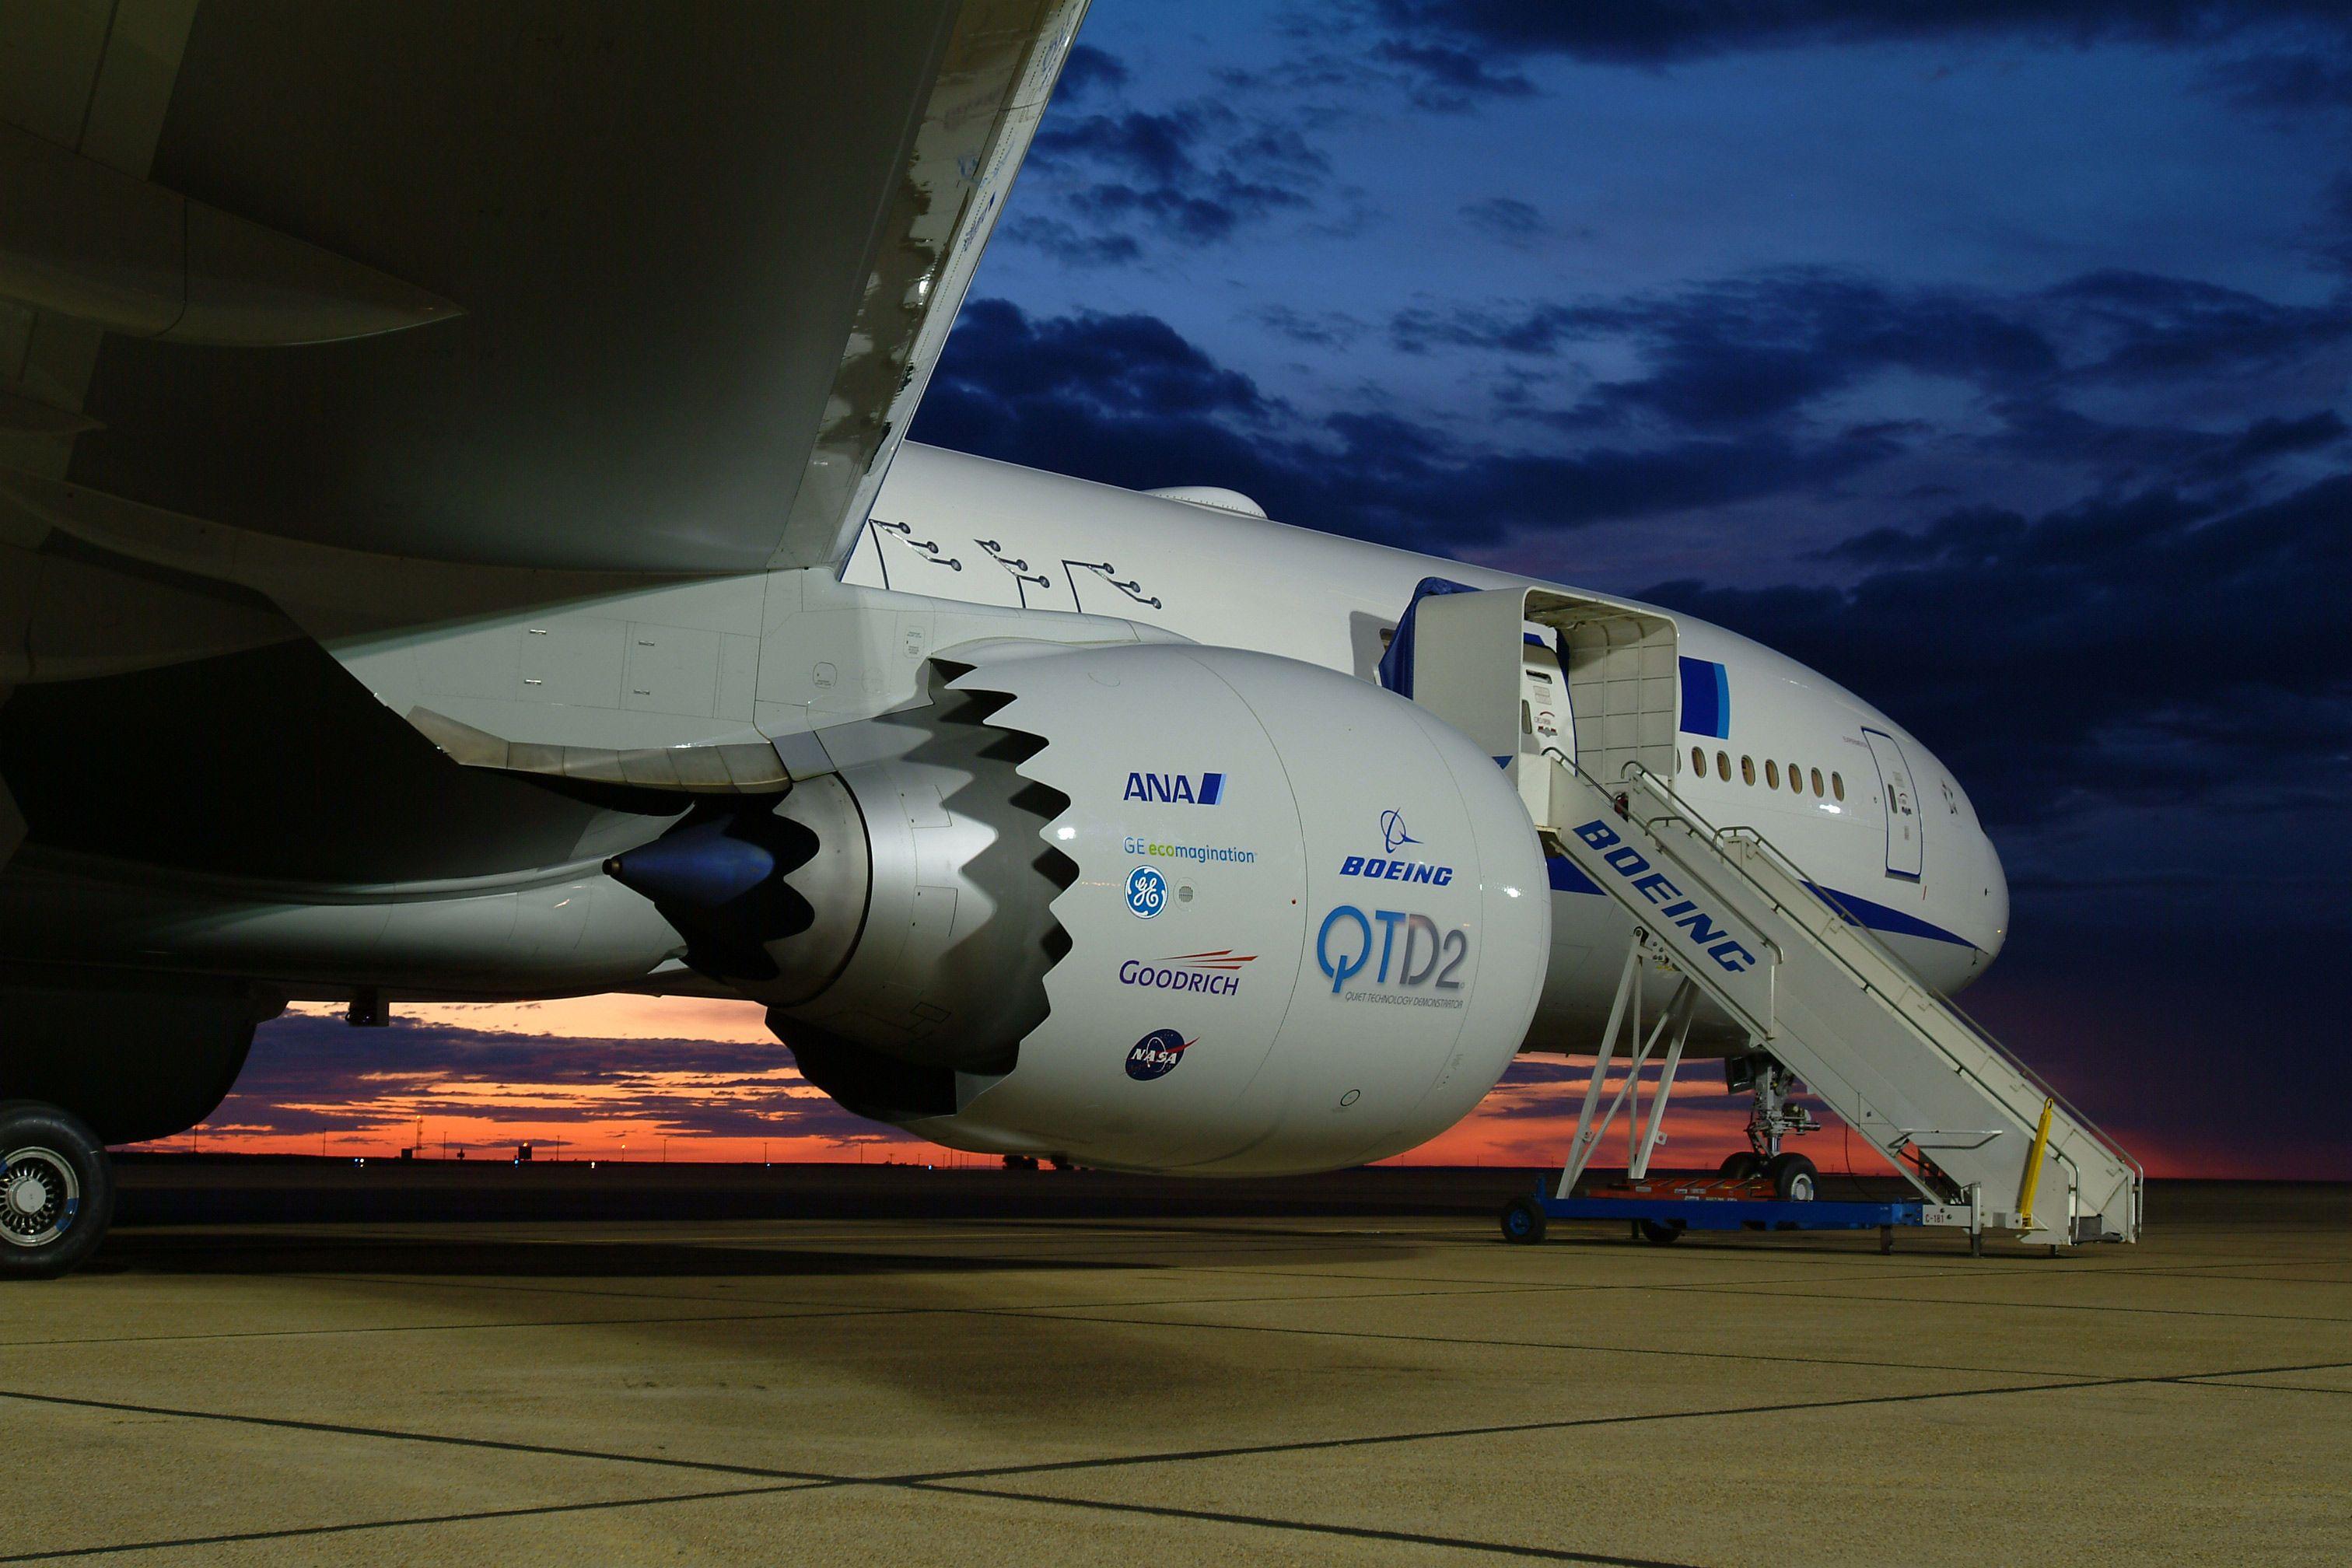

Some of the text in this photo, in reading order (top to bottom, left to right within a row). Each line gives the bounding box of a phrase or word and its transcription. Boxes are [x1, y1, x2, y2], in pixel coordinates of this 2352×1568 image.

[1123, 772, 1195, 803] ANA
[1125, 837, 1255, 863] GE ecomagination
[1339, 856, 1453, 886] BOEING
[1572, 820, 1755, 972] BOEING
[1317, 905, 1468, 993] QTD2
[1345, 991, 1464, 1010] QUIET TECHNOLOGY DEMONSTRATOR
[1131, 1048, 1178, 1064] NASA
